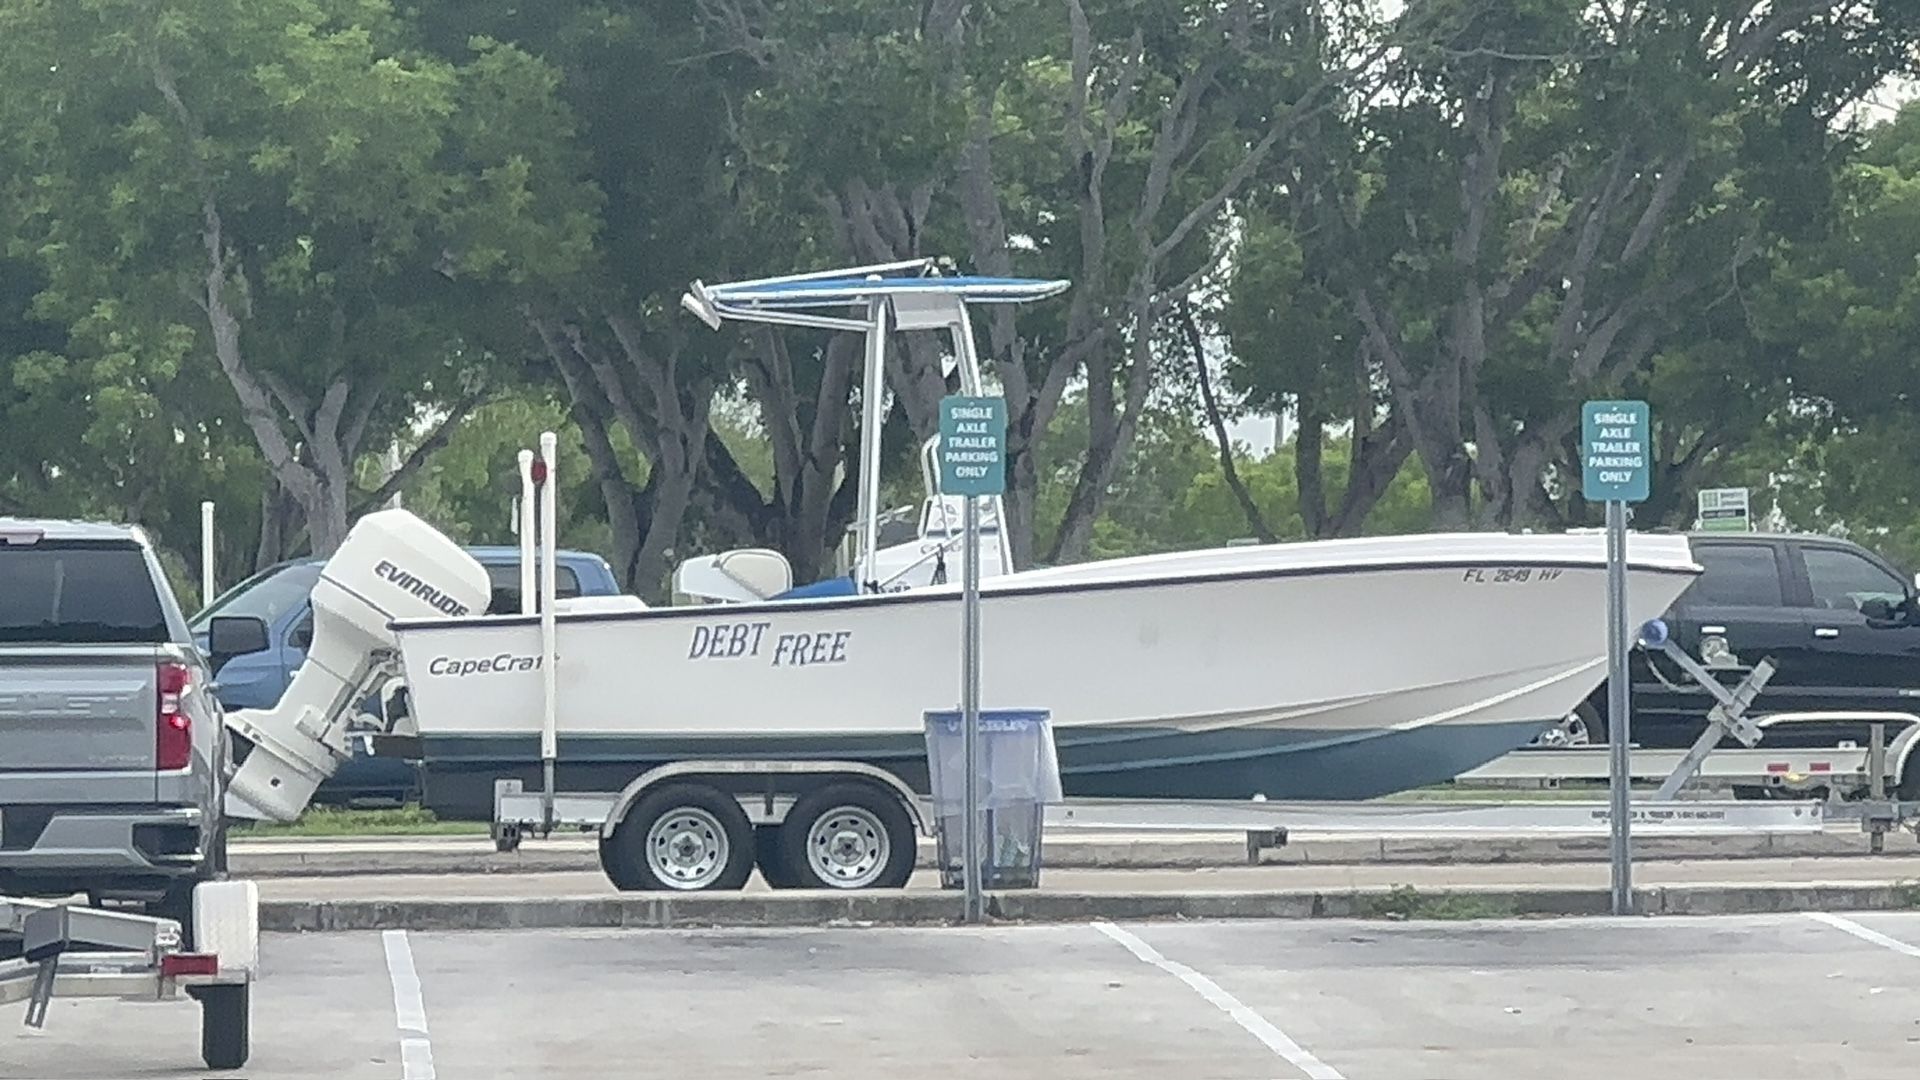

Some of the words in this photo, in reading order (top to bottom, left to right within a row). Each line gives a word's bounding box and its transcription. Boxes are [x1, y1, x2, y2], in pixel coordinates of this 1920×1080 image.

[951, 406, 993, 419] SINGLE
[1594, 413, 1638, 425] SINGLE
[956, 422, 987, 433] AXLE
[1600, 427, 1632, 439] AXLE
[948, 436, 997, 448] TRAILER
[1591, 441, 1640, 453] TRAILER
[945, 451, 998, 462] PARKING
[1588, 456, 1643, 467] PARKING
[955, 465, 988, 478] ONLY
[1599, 471, 1633, 482] ONLY
[1463, 568, 1485, 582] FL
[374, 559, 470, 616] EVINRUDE
[688, 622, 771, 660] DEBT
[771, 631, 852, 667] FREE
